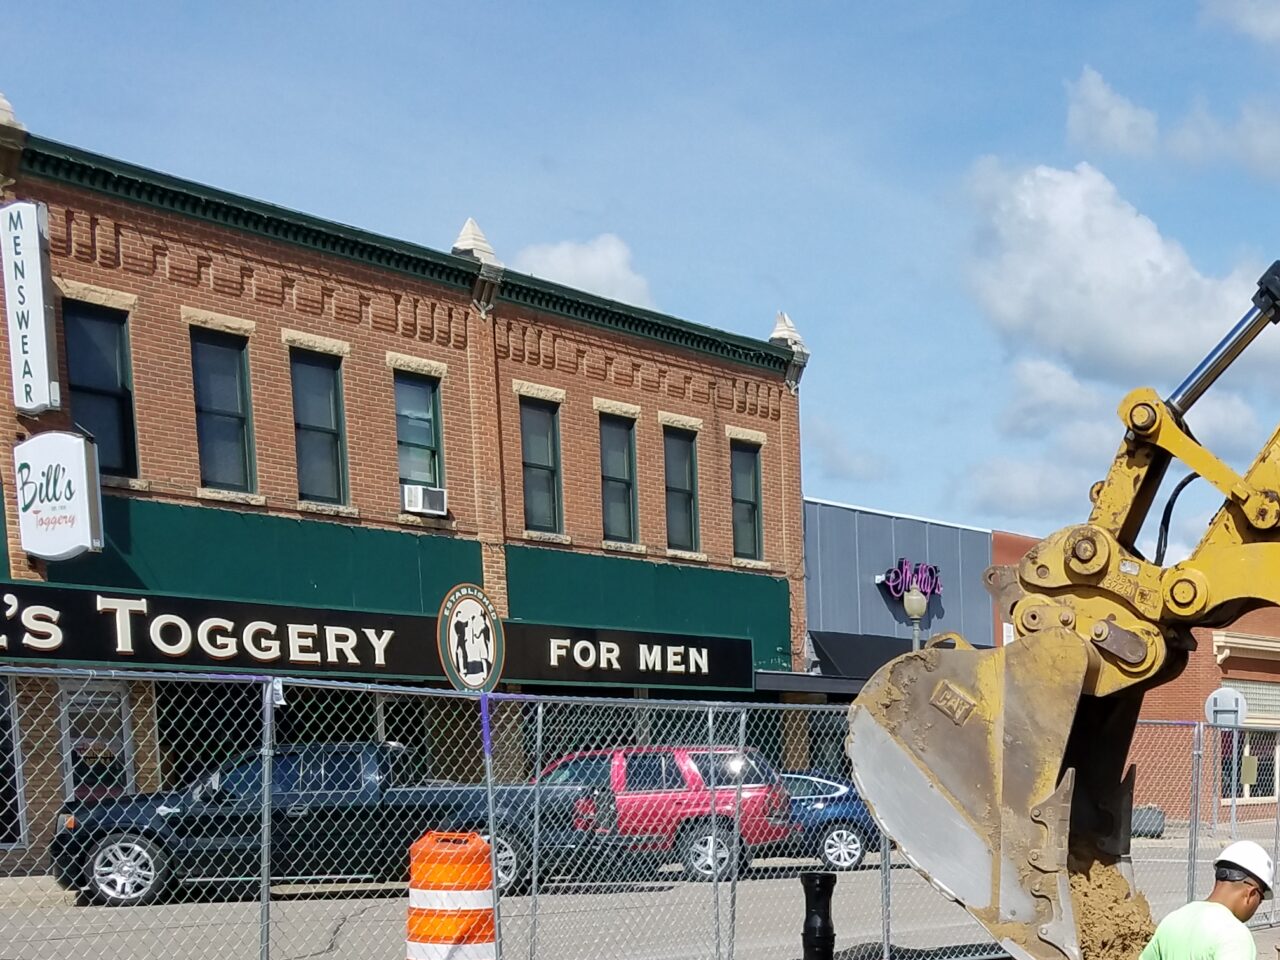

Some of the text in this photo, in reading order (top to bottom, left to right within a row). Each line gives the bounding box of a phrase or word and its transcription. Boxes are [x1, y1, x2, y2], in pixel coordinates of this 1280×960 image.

[9, 210, 33, 403] MENSWEAR
[18, 462, 75, 512] Bill's
[32, 509, 76, 532] Toggery
[444, 588, 497, 620] ESTABLISHED
[0, 593, 709, 675] 'S TOGGERY FOR MEN
[936, 689, 970, 720] CAT
